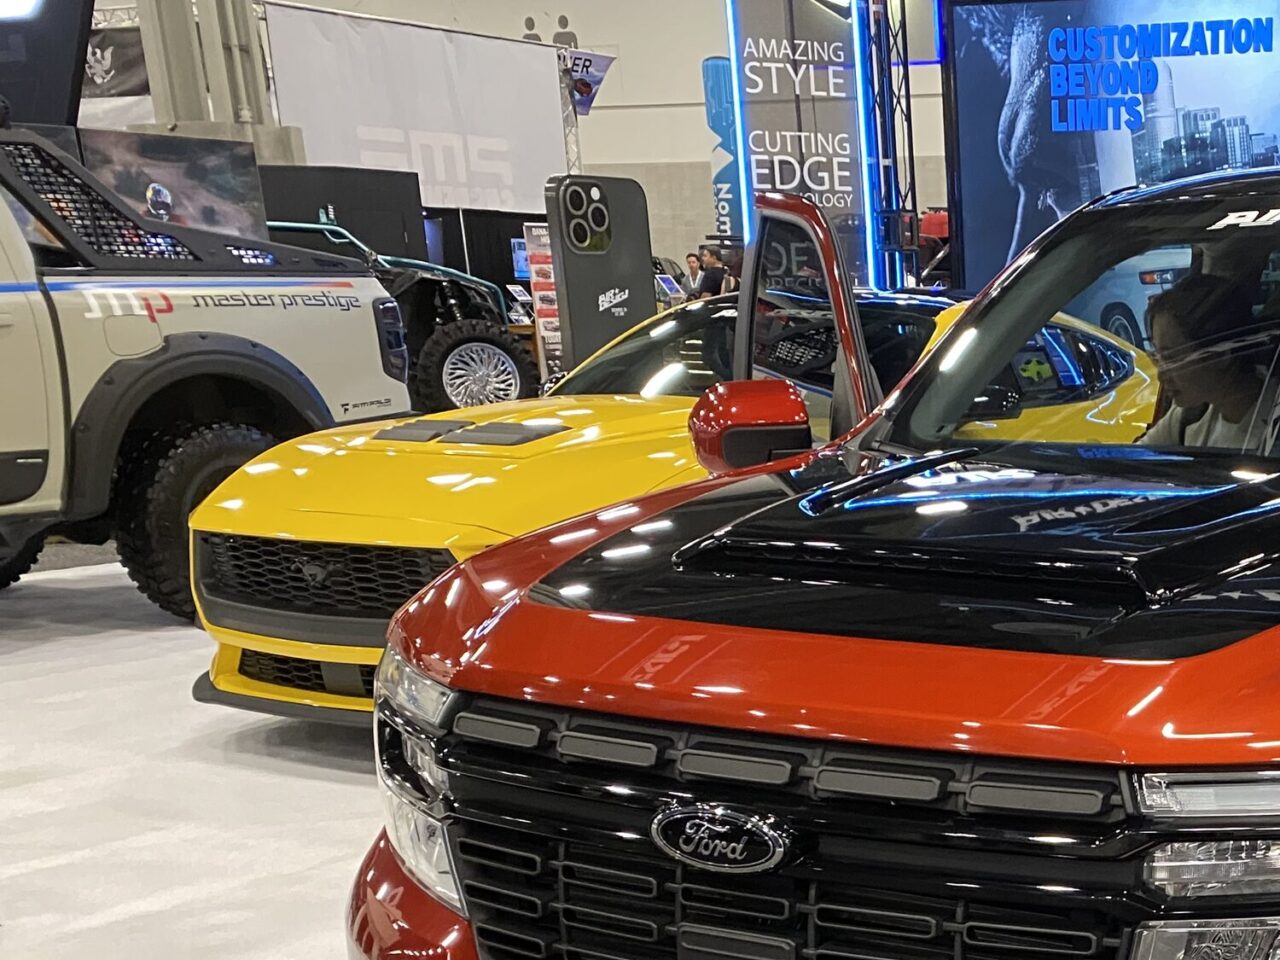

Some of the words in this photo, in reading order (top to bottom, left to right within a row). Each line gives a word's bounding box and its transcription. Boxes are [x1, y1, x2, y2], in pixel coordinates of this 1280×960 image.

[743, 37, 844, 62] AMAZING
[1048, 17, 1274, 63] CUSTOMIZATION
[744, 61, 847, 97] STYLE
[1050, 59, 1159, 97] BEYOND
[1051, 96, 1144, 132] LIMITS
[749, 130, 850, 155] CUTTING
[751, 155, 853, 191] EDGE
[192, 291, 276, 309] master
[280, 290, 362, 312] prestige
[679, 819, 749, 861] Ford
